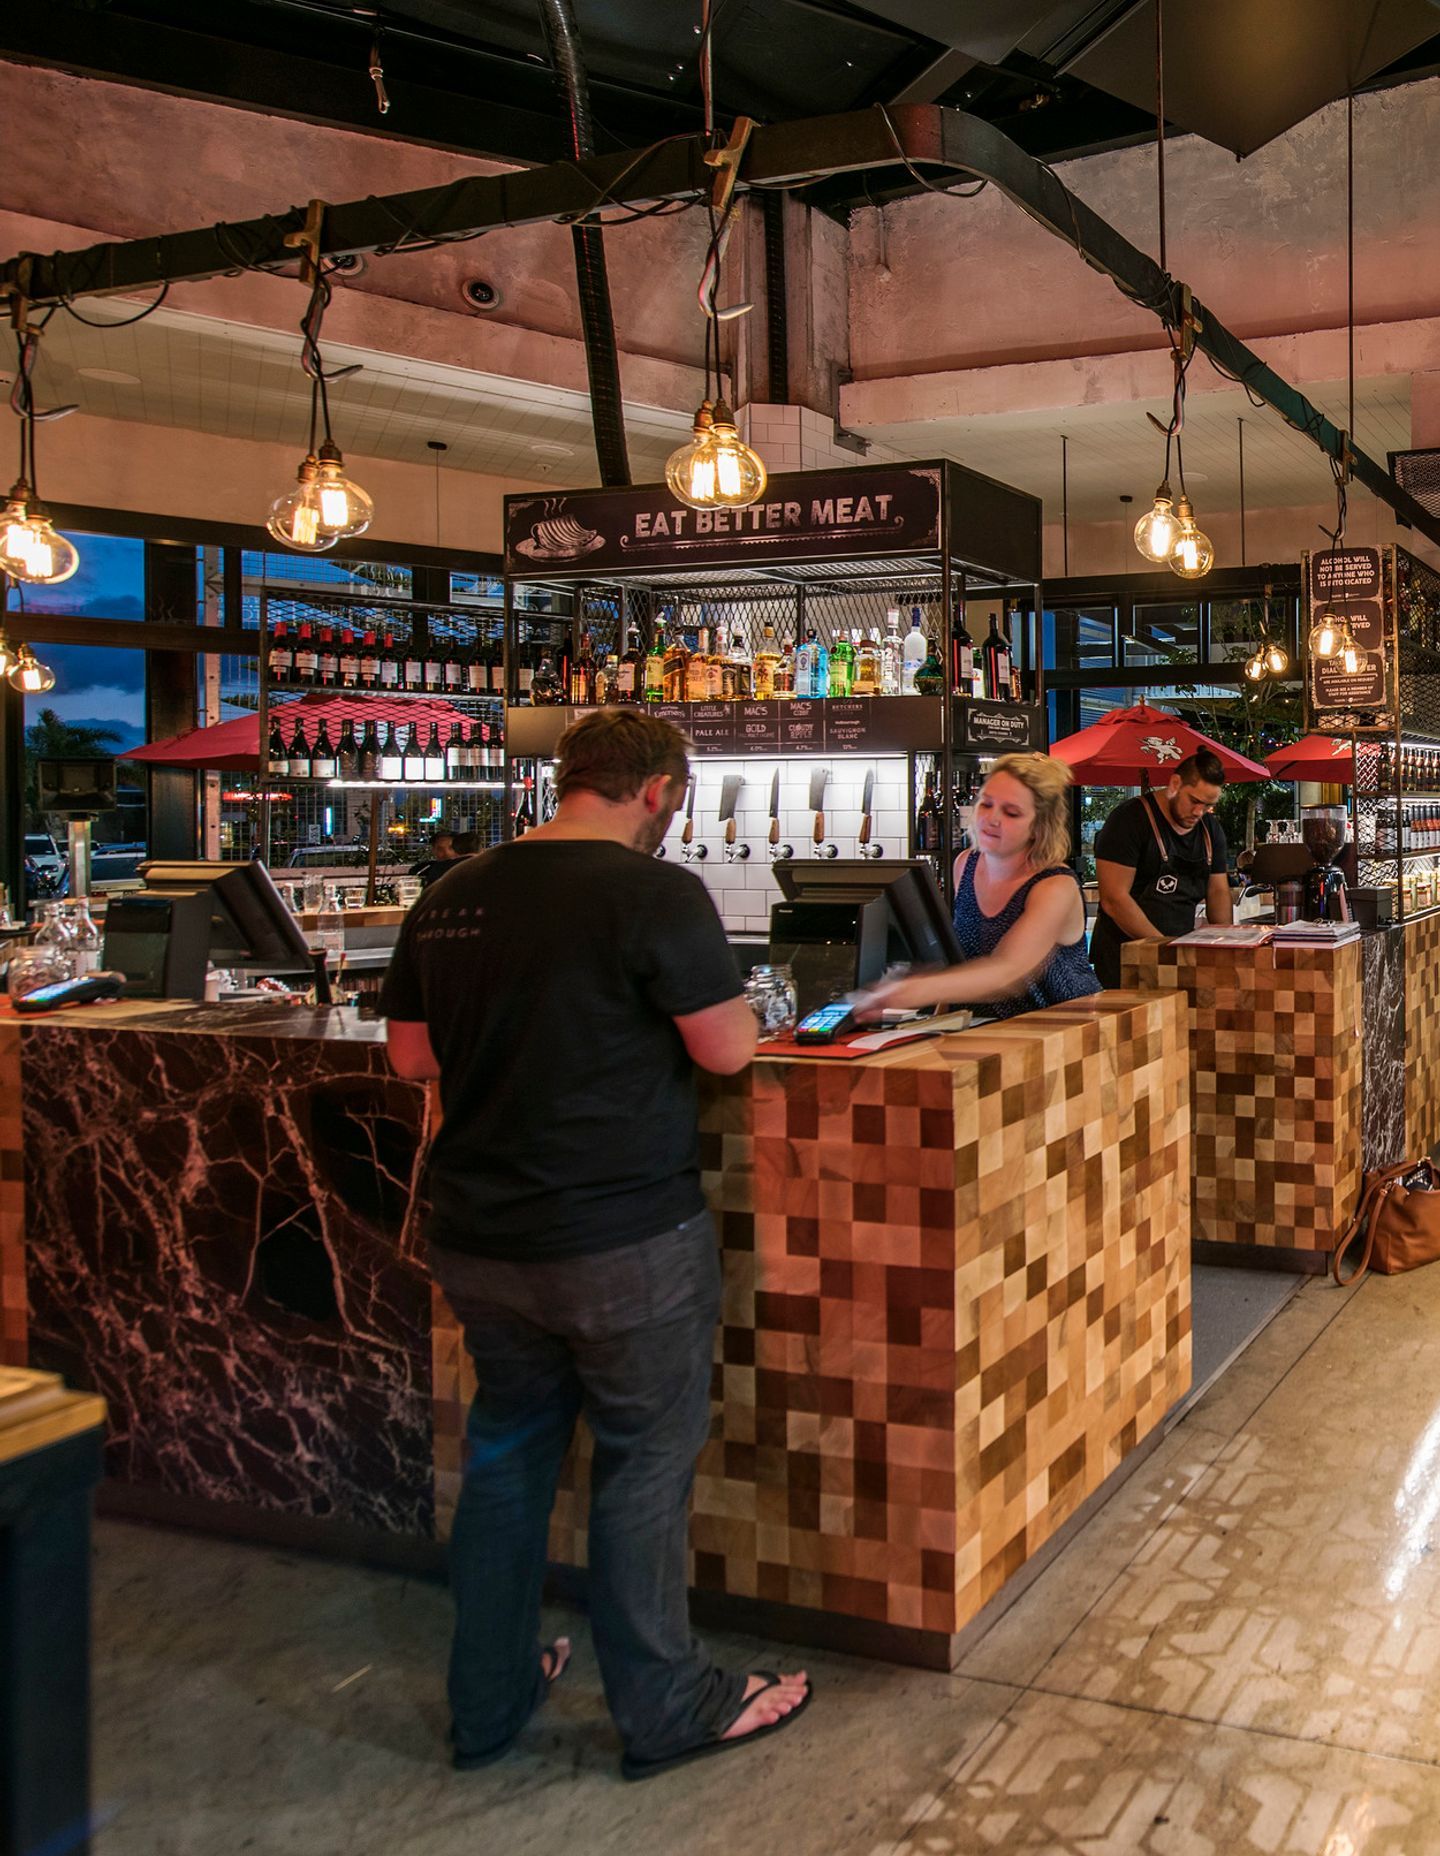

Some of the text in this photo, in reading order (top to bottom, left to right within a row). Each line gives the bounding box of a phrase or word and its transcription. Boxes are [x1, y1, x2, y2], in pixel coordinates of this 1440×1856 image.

[635, 494, 893, 538] EAT BETTER MEAT
[790, 702, 812, 710] MAC'S
[744, 706, 768, 716] MAC'S
[974, 717, 1000, 726] MANAGER
[745, 724, 767, 733] GOLD
